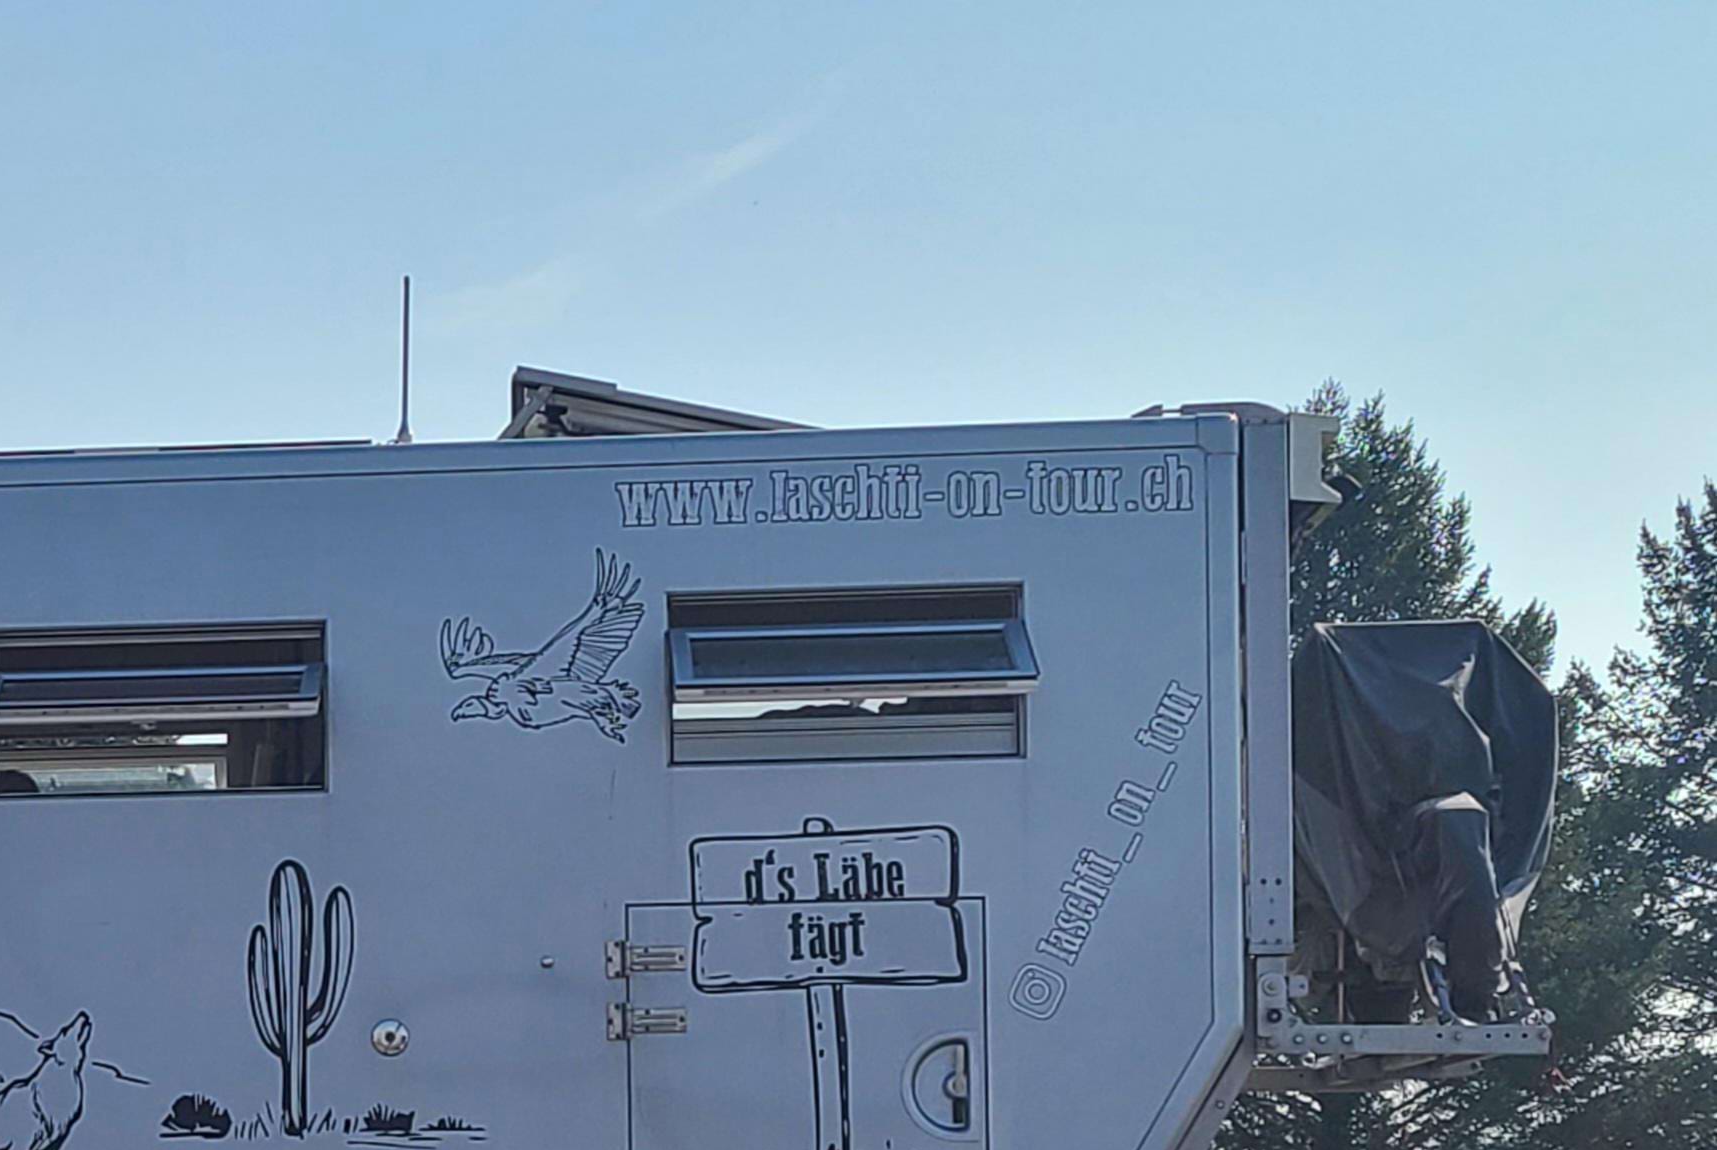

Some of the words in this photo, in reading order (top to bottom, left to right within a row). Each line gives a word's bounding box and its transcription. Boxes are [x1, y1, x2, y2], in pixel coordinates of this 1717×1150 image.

[614, 455, 1195, 527] www.laschti-on-tour.ch
[813, 852, 905, 900] Läbe
[787, 912, 866, 966] fägt
